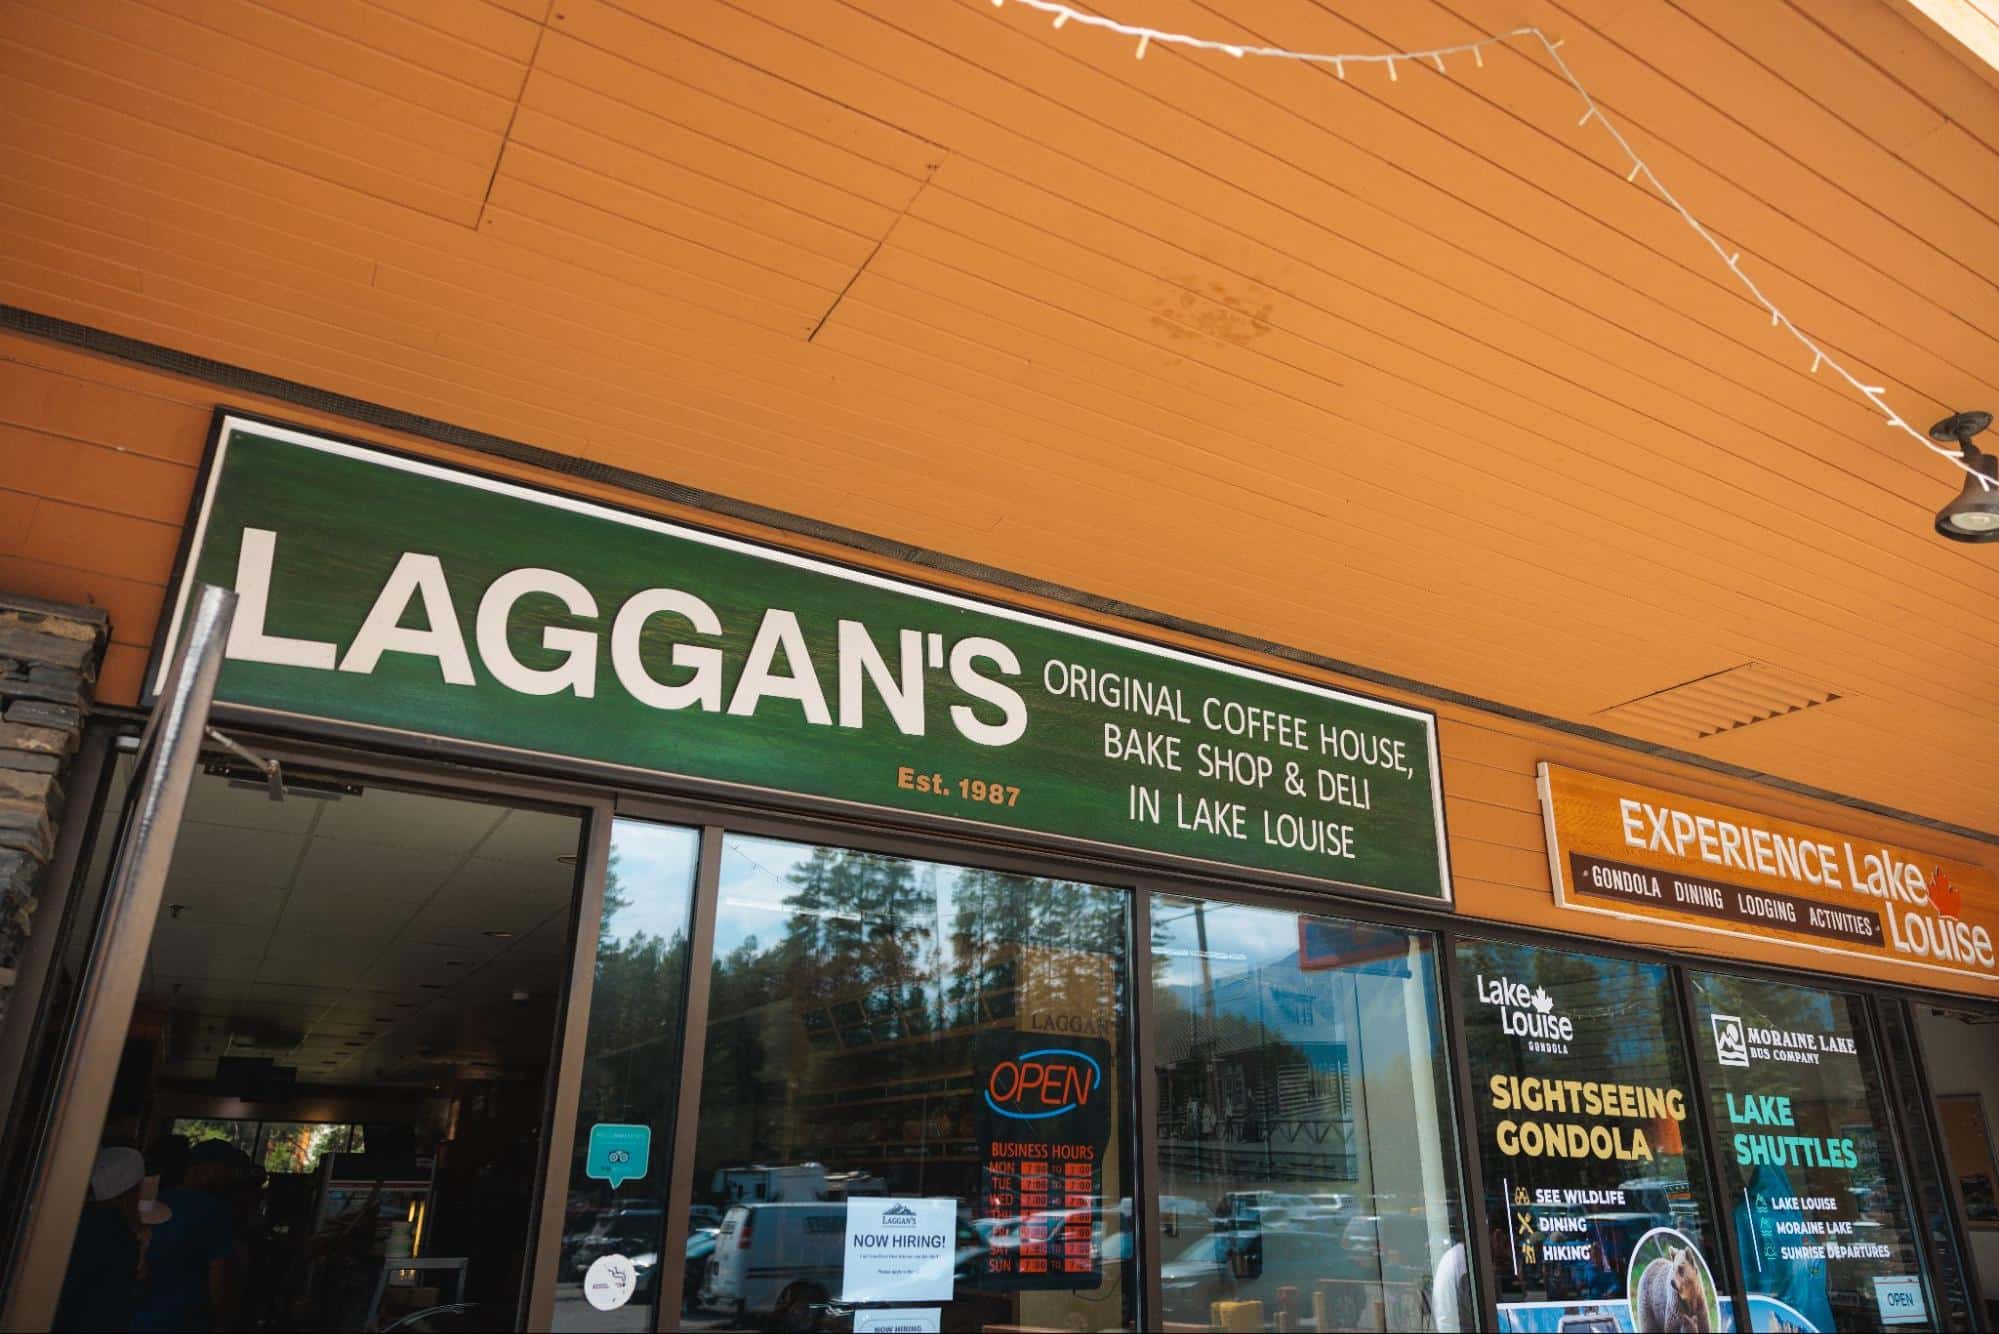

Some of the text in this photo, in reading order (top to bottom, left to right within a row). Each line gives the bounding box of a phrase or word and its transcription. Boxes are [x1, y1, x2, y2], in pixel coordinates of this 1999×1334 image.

[224, 527, 1029, 747] LAGGAN'S
[1043, 659, 1415, 781] ORIGINAL COFFEE HOUSE,
[1103, 722, 1371, 810] BAKE SHOP & DELI
[896, 765, 1022, 808] Est. 1987
[1128, 784, 1357, 859] IN LAKE LOUISE
[1618, 797, 1930, 907] EXPERIENCE Lake
[1591, 864, 1874, 937] GONDOLA DINING LODGING ACTIVITIES
[1885, 901, 1996, 969] Louise
[1476, 974, 1532, 1009] Lake
[1501, 1007, 1574, 1041] Louise
[1528, 1041, 1569, 1055] GONDOLA
[1747, 1027, 1857, 1055] MORAINE LAKE
[1750, 1047, 1820, 1065] BUS COMPANY
[990, 1061, 1093, 1105] OPEN
[1489, 1074, 1687, 1121] SIGHTSEEING
[1726, 1093, 1795, 1128] LAKE
[991, 1141, 1095, 1161] BUSINESS HOURS
[1496, 1120, 1654, 1162] GONDOLA
[1734, 1134, 1859, 1169] SHUTTLES
[989, 1161, 1015, 1174] MON
[991, 1177, 1012, 1190] TUE
[1535, 1188, 1626, 1206] SEE WILDLIFE
[1771, 1196, 1838, 1211] LAKE LOUISE
[1539, 1216, 1587, 1233] DINING
[1776, 1221, 1854, 1235] MORAINE LAKE
[853, 1234, 946, 1249] NOW HIRING!
[1543, 1244, 1591, 1261] HIKING
[1780, 1245, 1891, 1260] SUNRISE DEPARTURES
[988, 1259, 1012, 1273] SUN
[1887, 1292, 1915, 1307] OPEN
